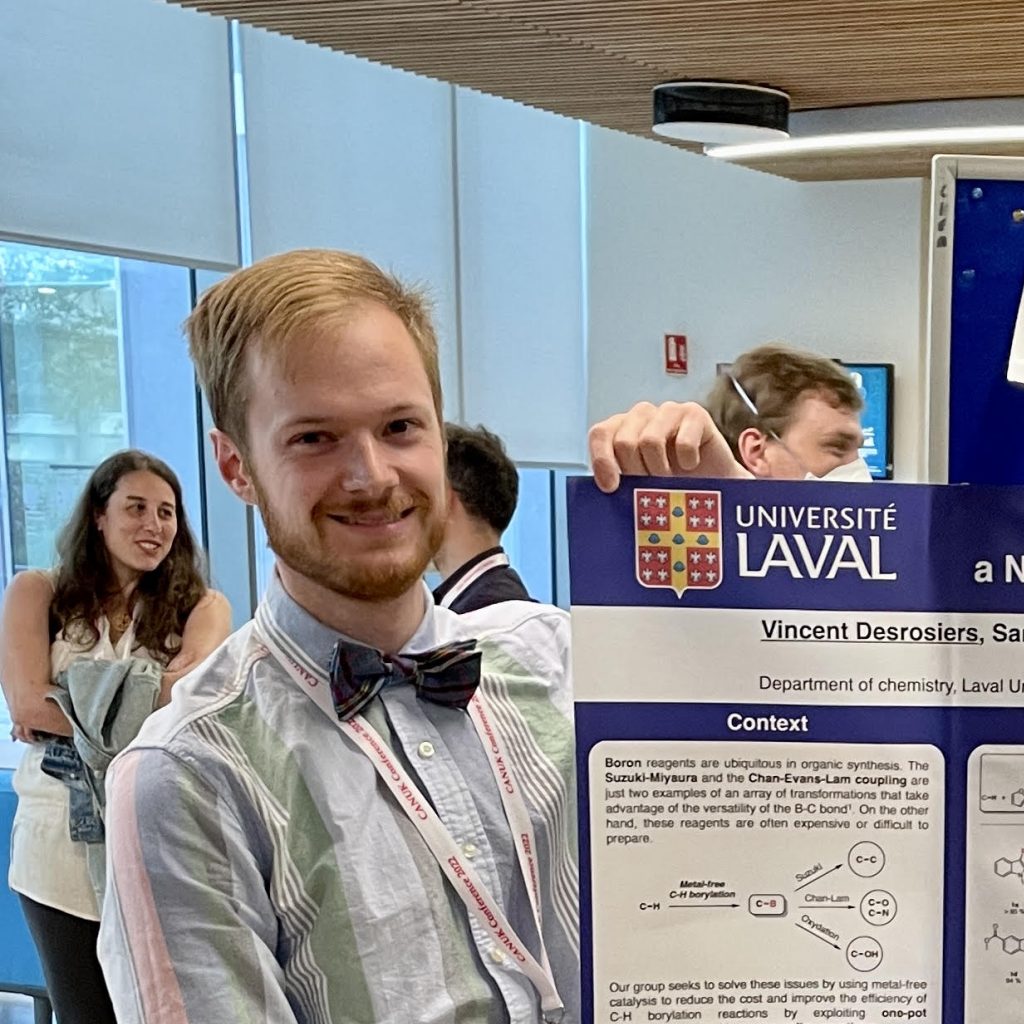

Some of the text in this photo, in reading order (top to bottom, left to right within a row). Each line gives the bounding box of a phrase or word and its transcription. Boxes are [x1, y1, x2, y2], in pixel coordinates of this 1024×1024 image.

[736, 504, 897, 530] UNIVERSITÉ
[736, 533, 897, 580] LAVAL
[974, 560, 994, 583] a
[762, 620, 848, 643] Vincent
[855, 623, 984, 646] Desrosiers,
[759, 675, 854, 693] Department
[858, 677, 874, 692] of
[878, 677, 957, 696] chemistry,
[962, 677, 1004, 693] Laval
[726, 712, 809, 732] Context
[362, 731, 401, 782] Conference
[605, 757, 643, 768] Boron
[646, 758, 697, 771] reagents
[700, 759, 720, 768] are
[724, 758, 783, 770] ubiquitous
[786, 760, 797, 769] in
[801, 760, 844, 772] organic
[907, 760, 930, 771] The
[495, 757, 514, 794] CANUK
[605, 772, 930, 788] Suzuki-Miyaura and the Chan-Evans-Lam coupling are
[400, 782, 428, 820] CANUK
[447, 855, 526, 962] CANUK Conference 2022
